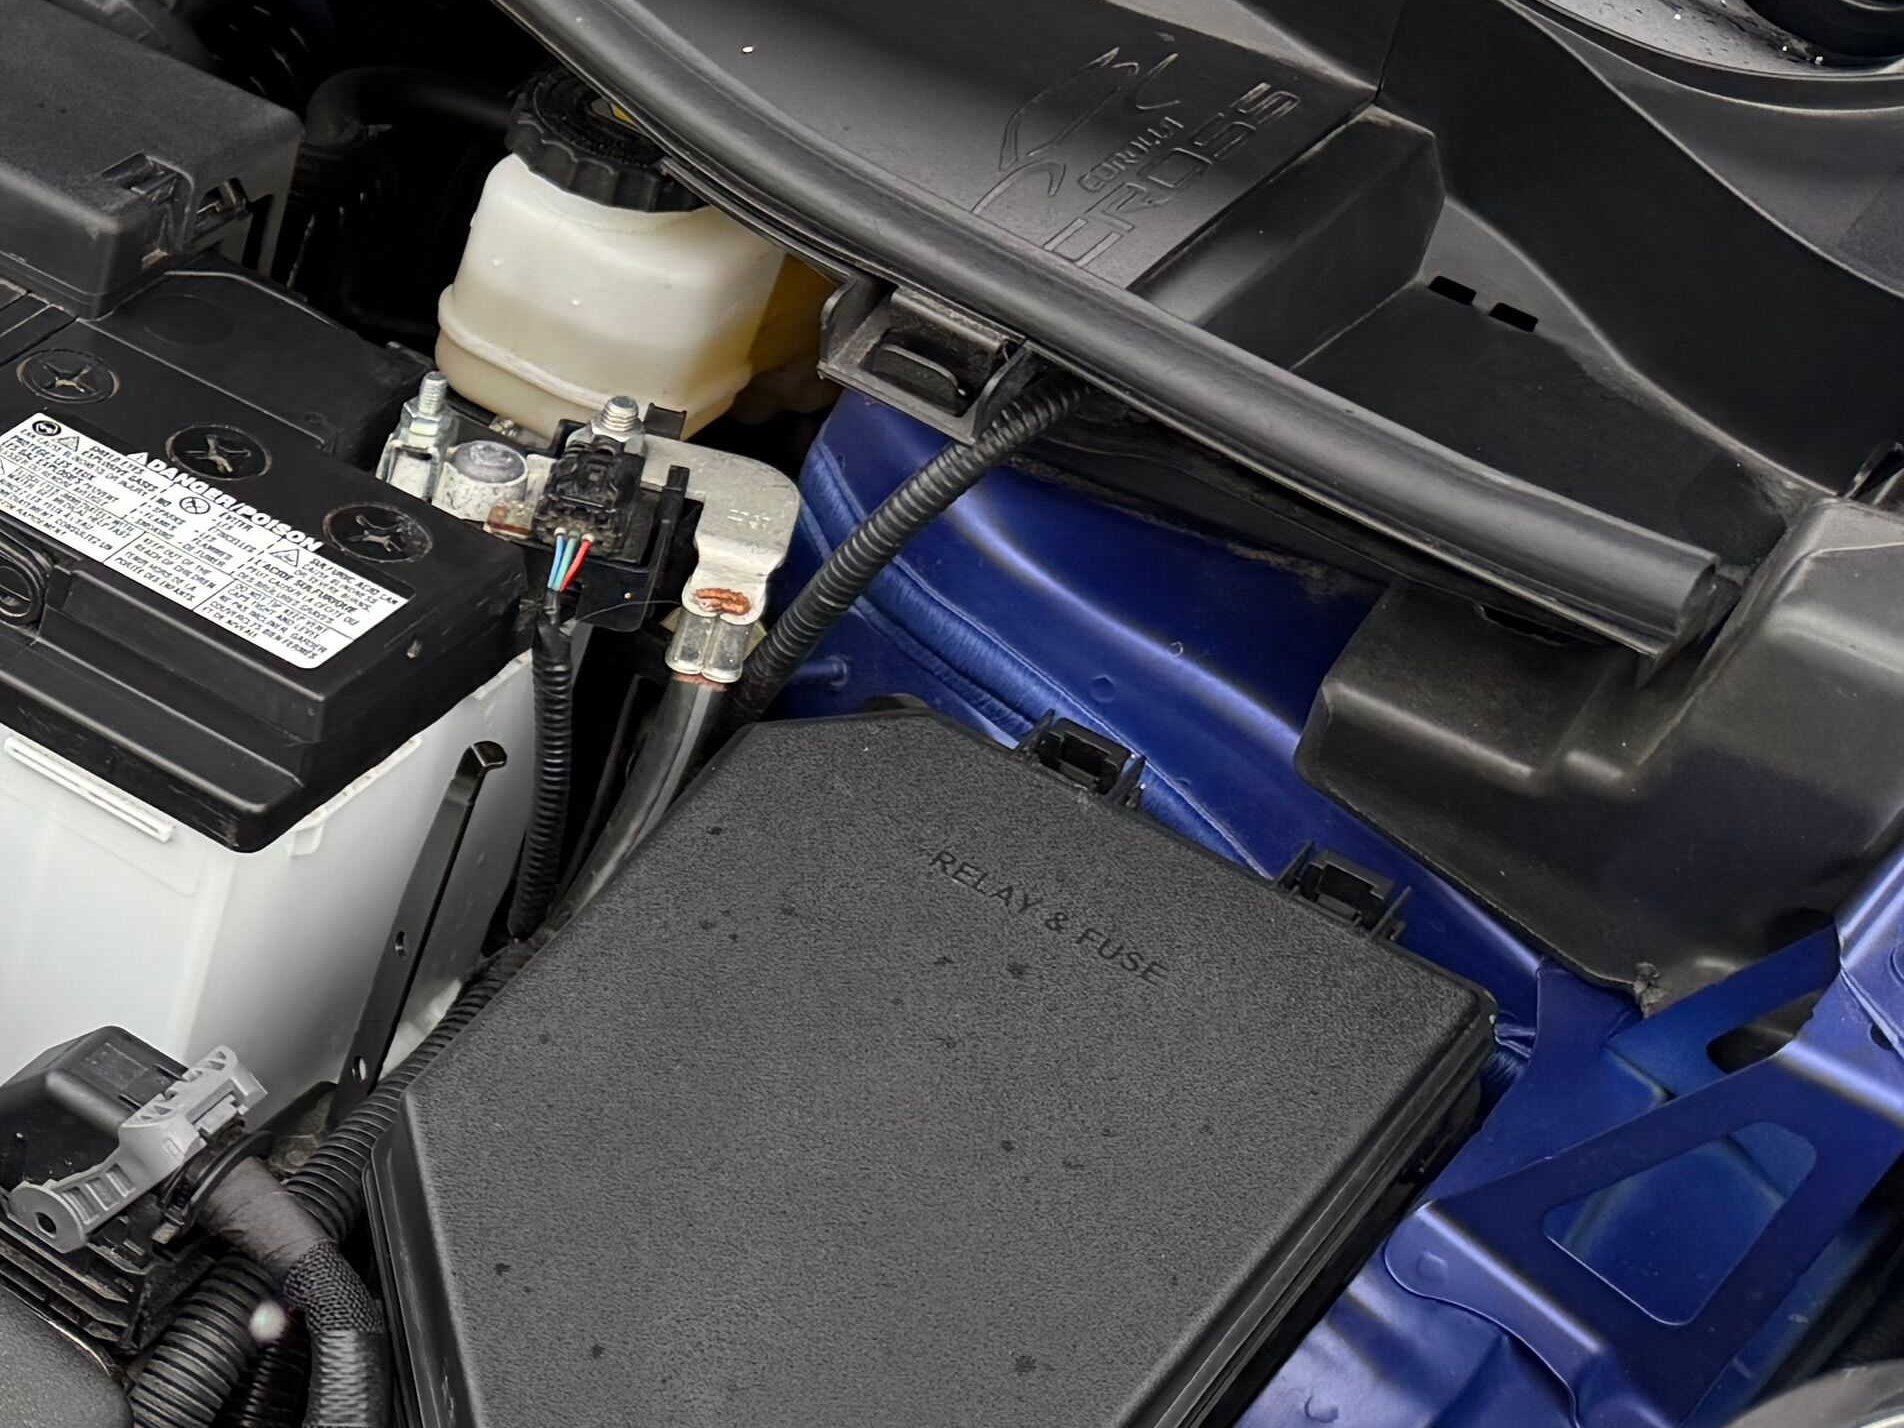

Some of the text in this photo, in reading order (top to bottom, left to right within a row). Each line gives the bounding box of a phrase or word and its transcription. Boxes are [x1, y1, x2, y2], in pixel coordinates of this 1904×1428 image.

[1044, 81, 1302, 267] CROSS
[1077, 115, 1185, 194] COROLLA
[147, 457, 323, 557] DANGER/POISON
[929, 848, 1171, 987] RELAY & FUSE
